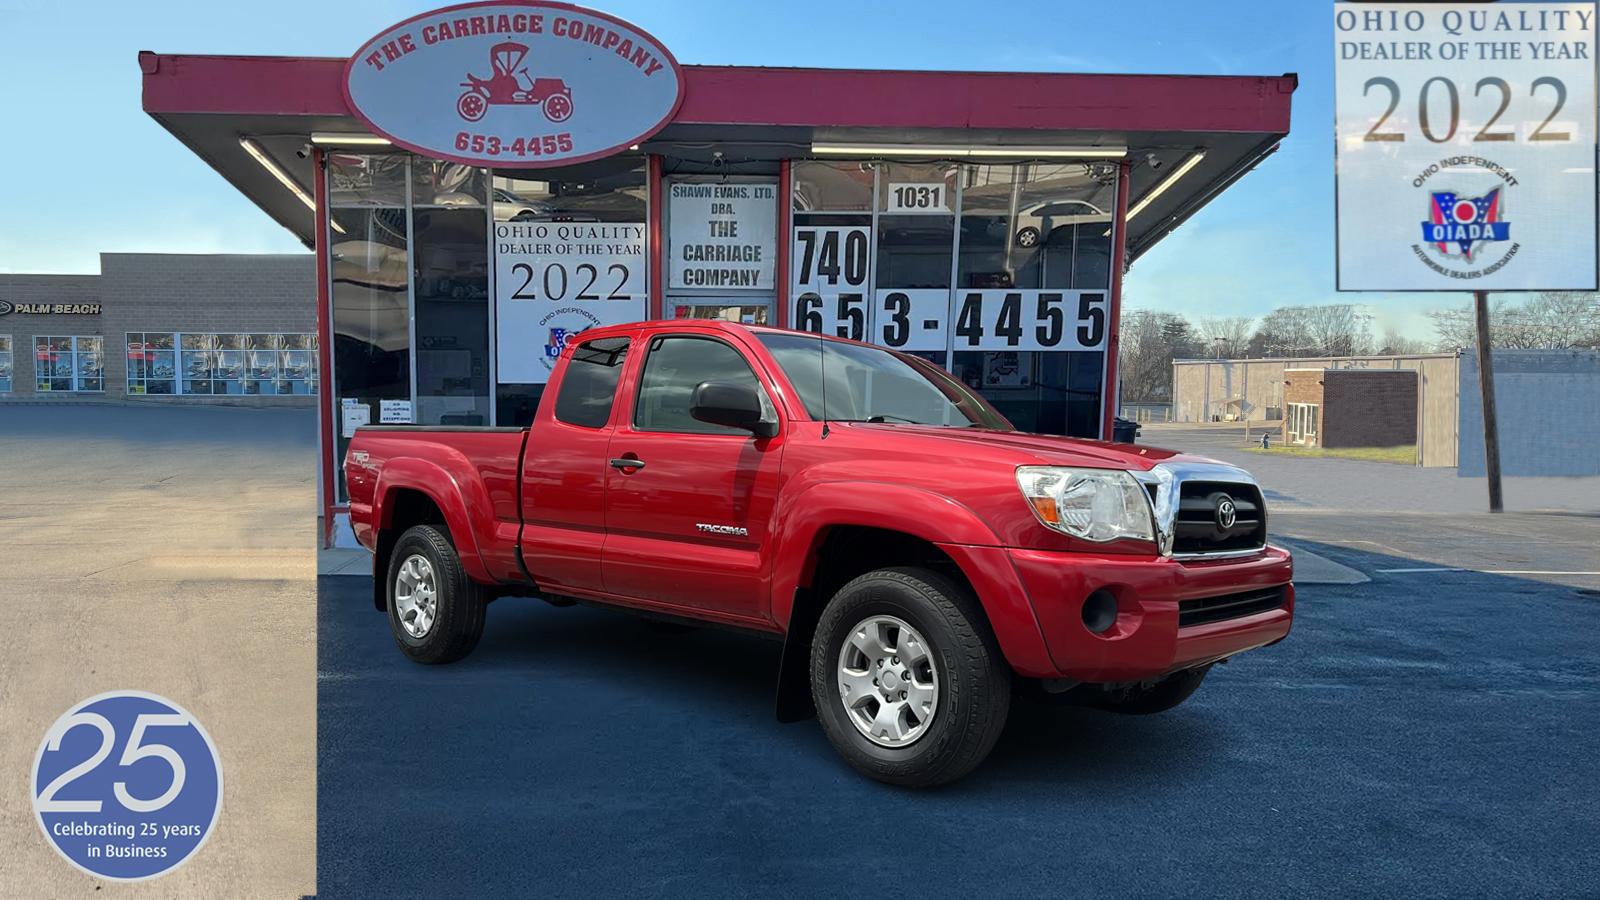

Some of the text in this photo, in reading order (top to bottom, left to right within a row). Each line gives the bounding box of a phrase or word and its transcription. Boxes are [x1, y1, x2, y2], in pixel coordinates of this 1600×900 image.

[1336, 10, 1593, 35] OHIO QUALITY
[365, 14, 664, 77] THE CARRIAGE COMPANY
[1340, 41, 1589, 60] DEALER OF THE YEAR
[1362, 76, 1571, 143] 2022
[454, 132, 573, 156] 653-4455
[1412, 155, 1519, 188] OHIO INDEPENDENT
[672, 186, 712, 198] SHAWN
[753, 187, 774, 199] LTD.
[894, 186, 941, 208] 1031
[711, 203, 736, 215] DBA.
[497, 226, 644, 241] OHIO QUALITY
[708, 220, 738, 238] THE
[1432, 225, 1495, 241] OIADA
[499, 244, 641, 255] DEALER OF THE YEAR
[683, 244, 762, 262] CARRIAGE
[798, 229, 868, 286] 740
[1411, 242, 1521, 280] AUTOMOBILE DEALERS ASSOCIATION
[510, 262, 631, 301] 2022
[683, 268, 760, 286] COMPANY
[15, 304, 100, 314] PALM BEACH
[539, 307, 601, 327] OHIO INDEPENDENT
[796, 292, 1105, 346] 653-4455
[696, 523, 748, 536] TACOMA
